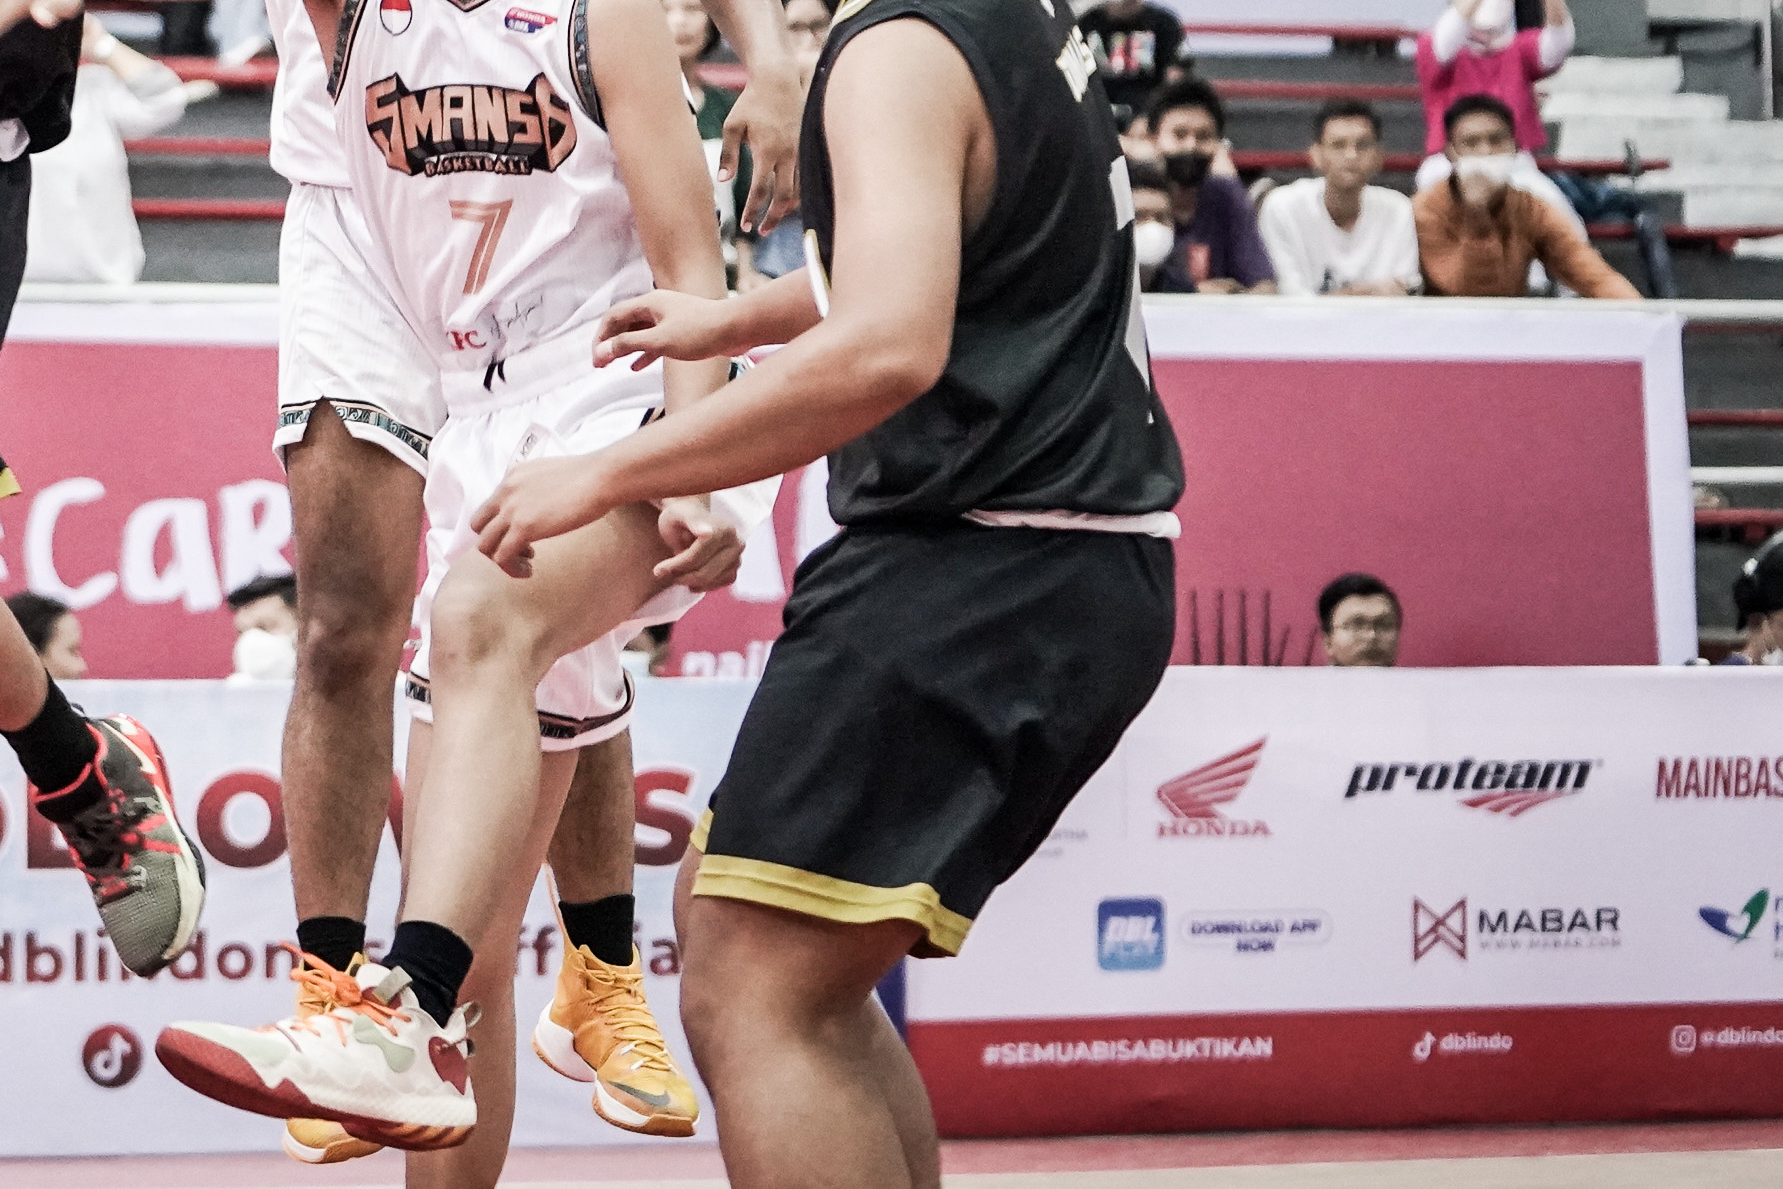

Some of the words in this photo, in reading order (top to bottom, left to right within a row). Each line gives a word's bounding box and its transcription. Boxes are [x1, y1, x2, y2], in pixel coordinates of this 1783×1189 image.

[365, 73, 578, 177] SMANSA
[424, 154, 534, 178] BASKETBALL
[448, 198, 514, 296] 7
[1344, 757, 1594, 799] proteam
[1156, 819, 1272, 840] HONDA
[1190, 919, 1282, 935] DOWNLOAD
[1290, 918, 1321, 934] APP
[1478, 908, 1621, 933] MABAR
[1236, 938, 1275, 953] NOW
[982, 1036, 1273, 1067] #SEMUABISABUKTIKAN
[1439, 1031, 1514, 1053] dblindo
